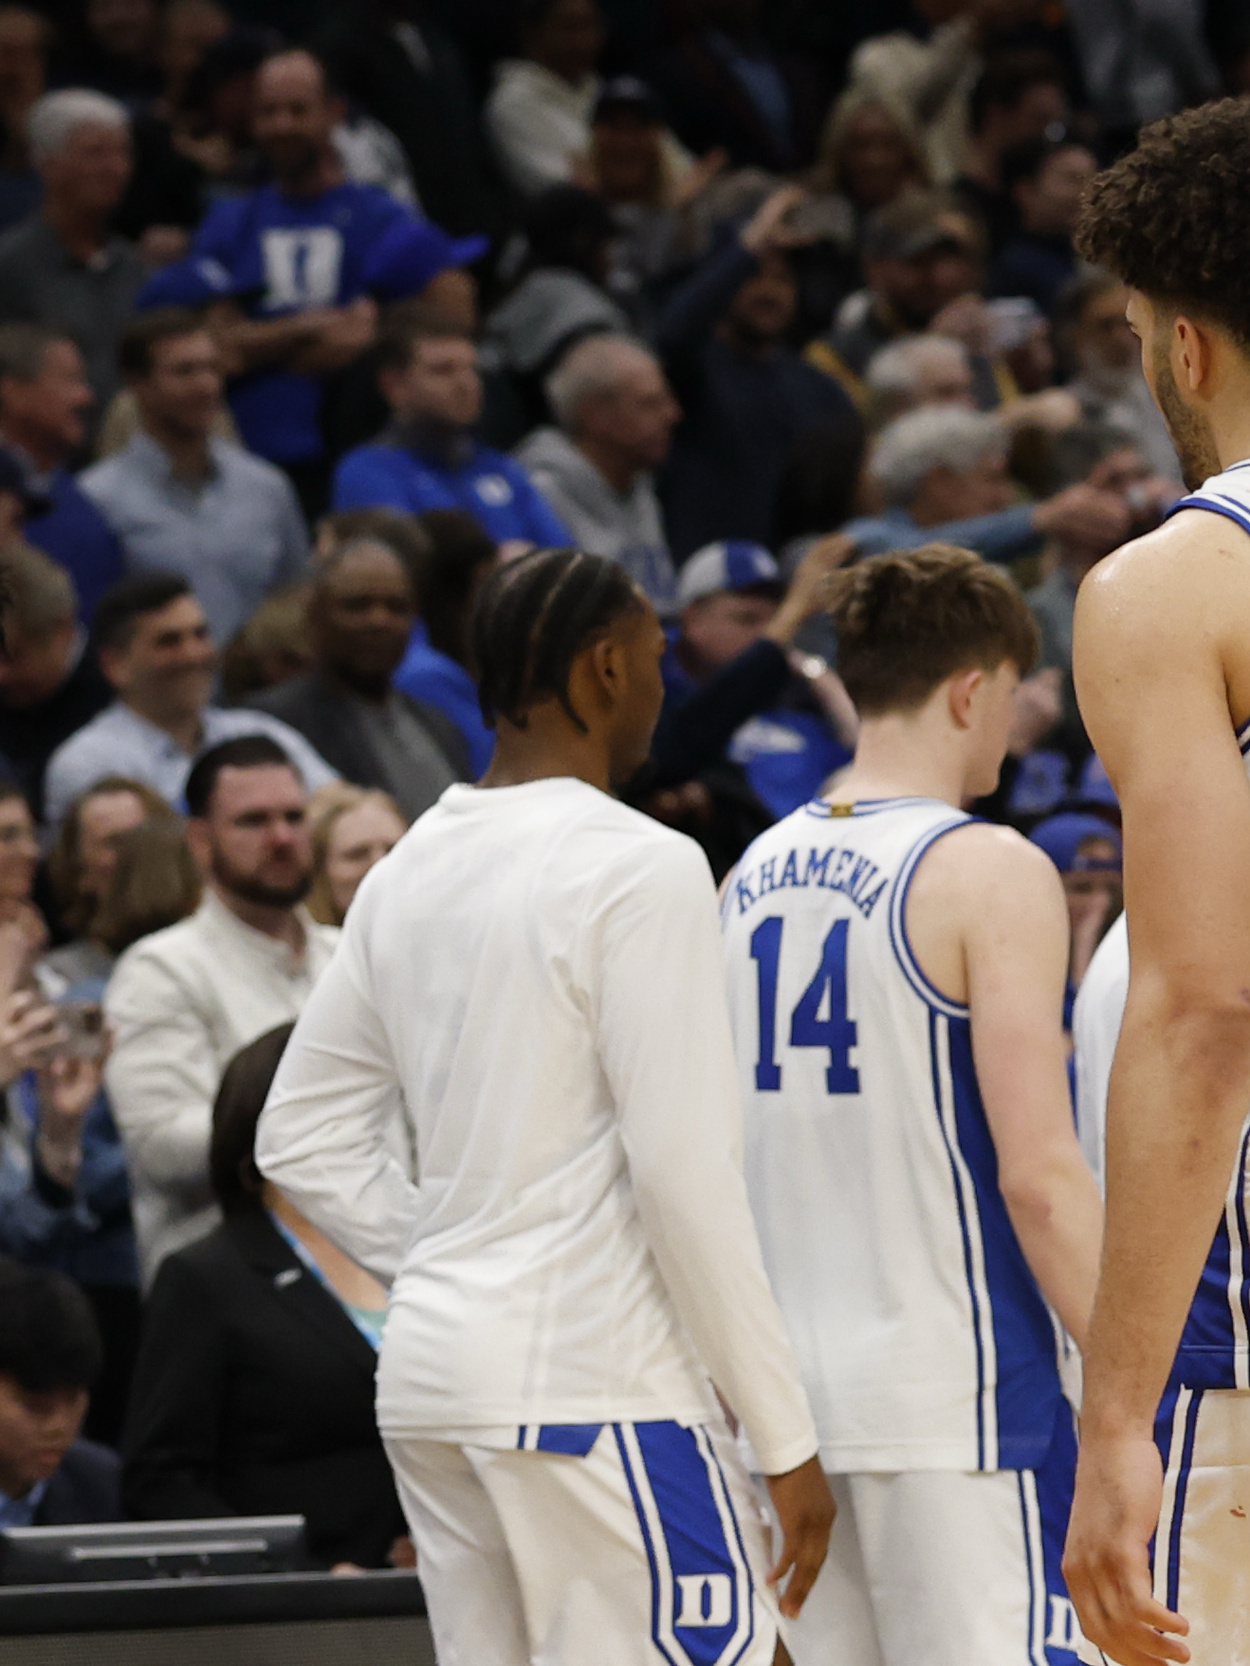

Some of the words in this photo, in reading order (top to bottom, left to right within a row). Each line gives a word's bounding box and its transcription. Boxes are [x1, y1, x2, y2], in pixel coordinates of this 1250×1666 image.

[735, 847, 890, 916] KHAMENIA
[750, 915, 862, 1096] 14
[674, 1572, 733, 1628] D
